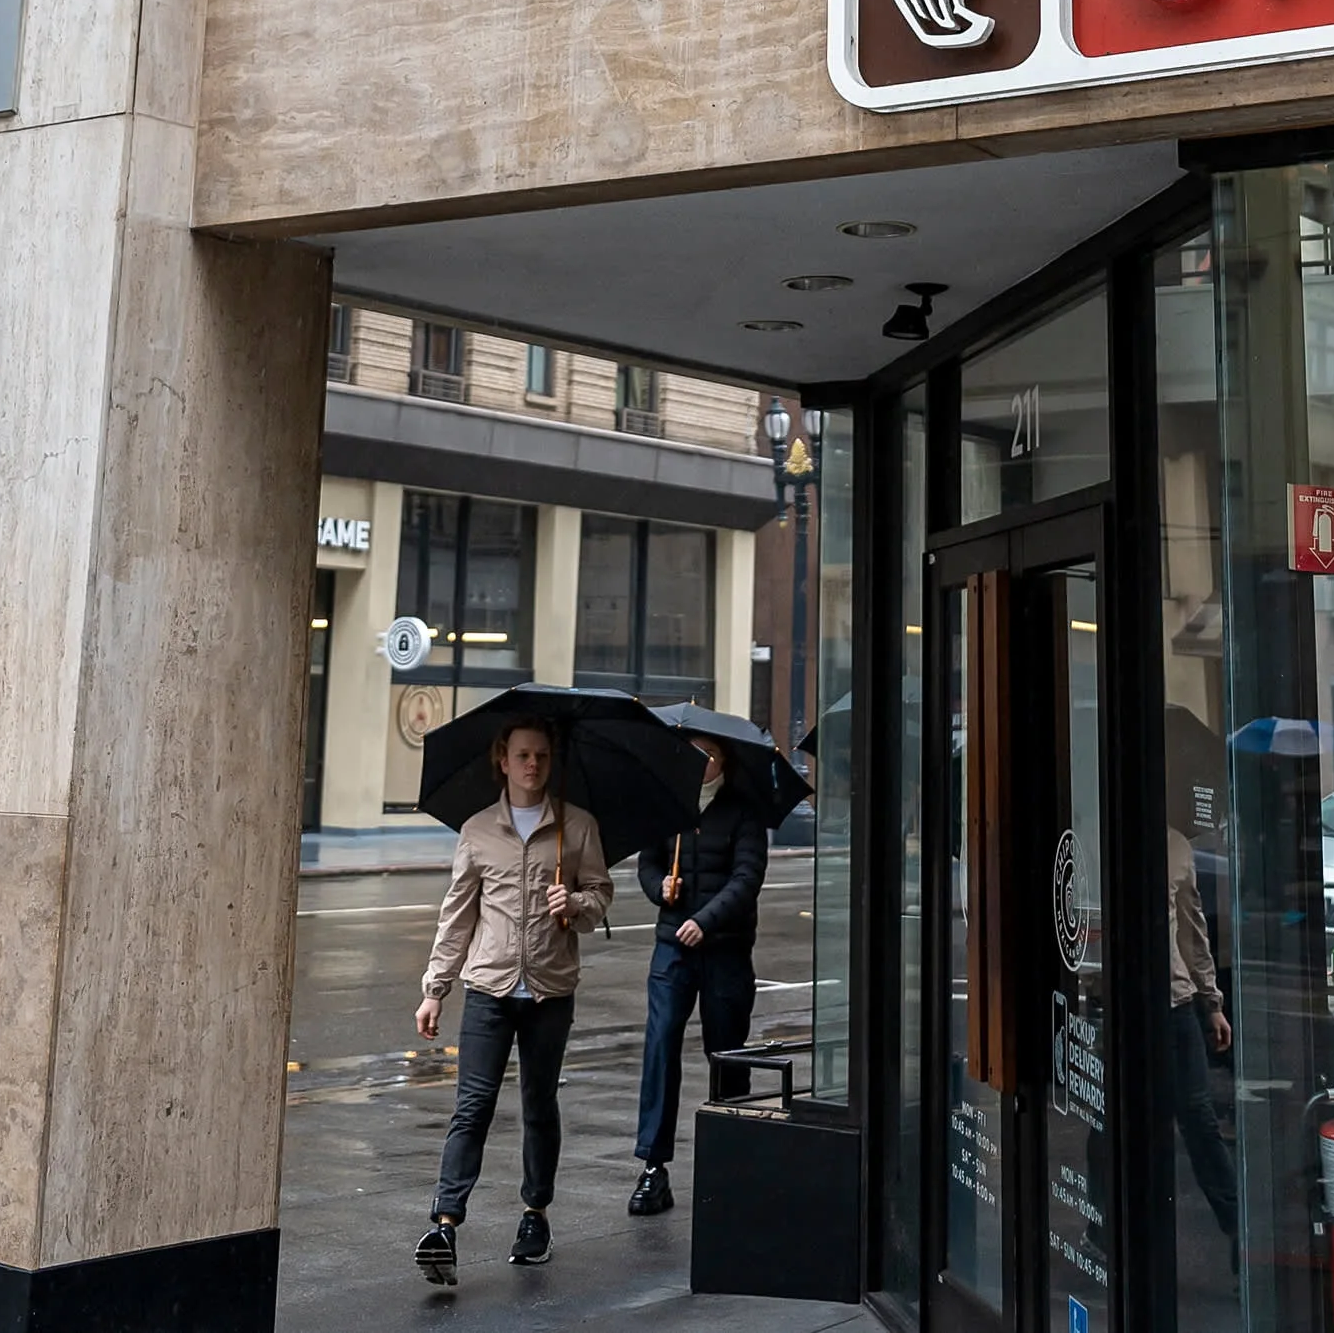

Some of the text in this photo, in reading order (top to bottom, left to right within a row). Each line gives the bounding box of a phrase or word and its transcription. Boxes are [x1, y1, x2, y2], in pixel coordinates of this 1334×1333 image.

[1010, 383, 1040, 459] 211
[1069, 1012, 1096, 1046] PICKUP
[1069, 1041, 1105, 1084] DELIVERY
